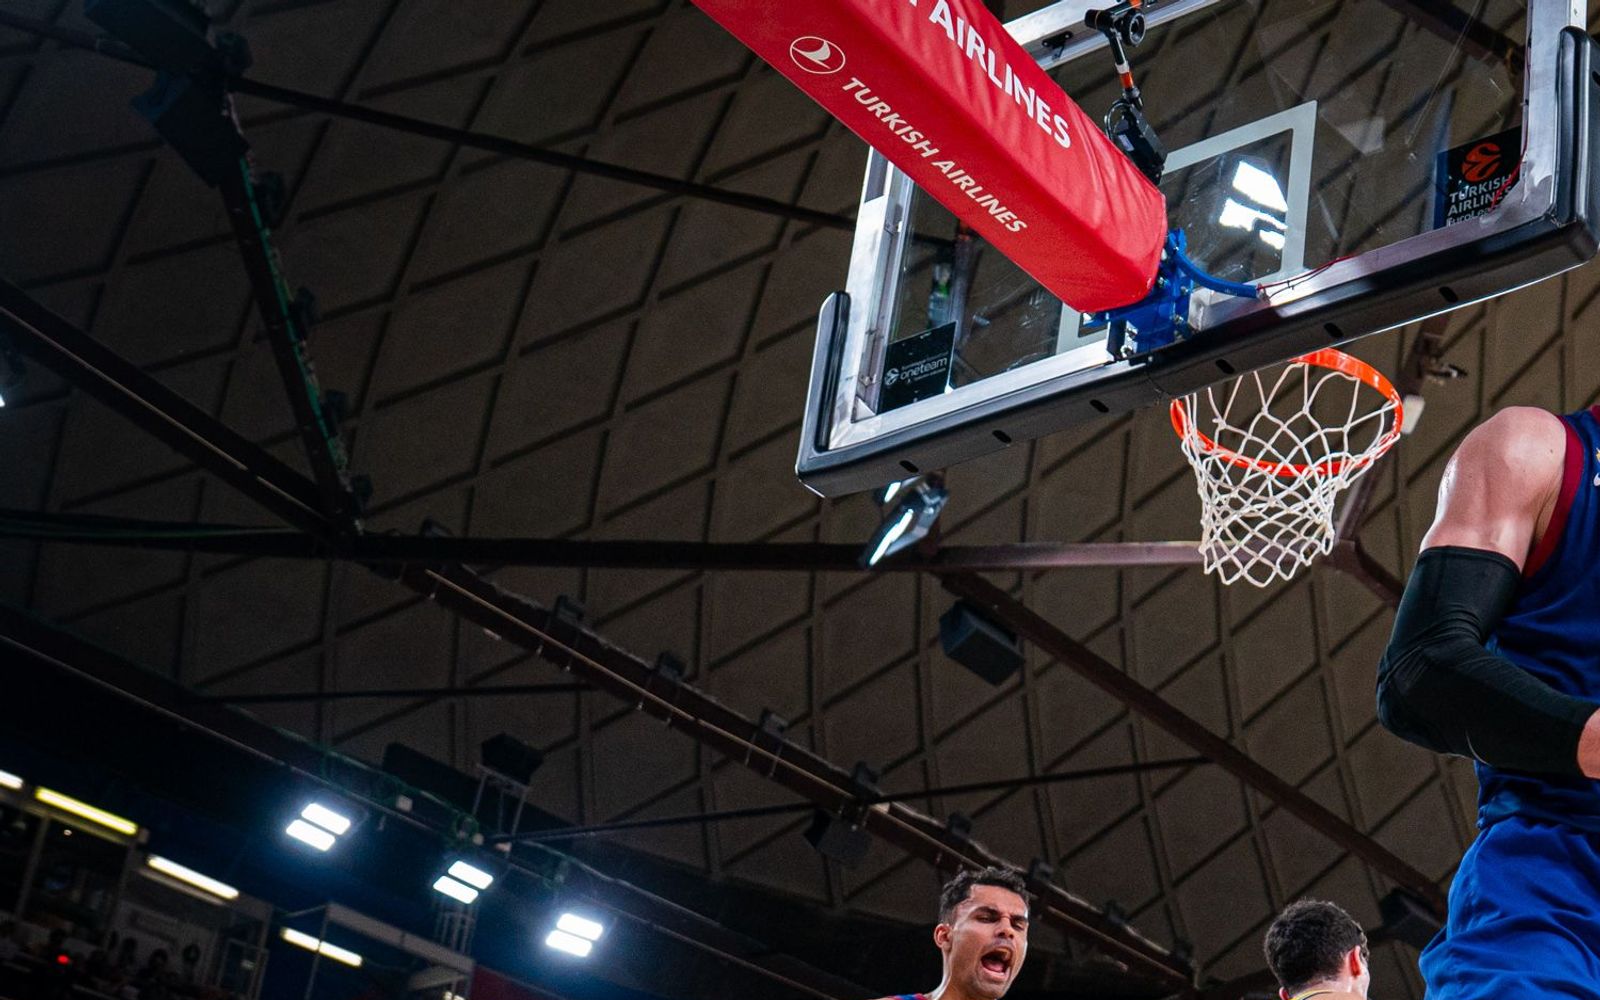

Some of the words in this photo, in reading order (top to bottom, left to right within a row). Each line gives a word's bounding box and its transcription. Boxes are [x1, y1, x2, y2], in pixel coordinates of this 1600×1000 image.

[928, 0, 1072, 149] AIRLINES
[842, 77, 940, 159] TURKISH
[933, 159, 1029, 233] AIRLINES
[900, 357, 948, 380] oneteam
